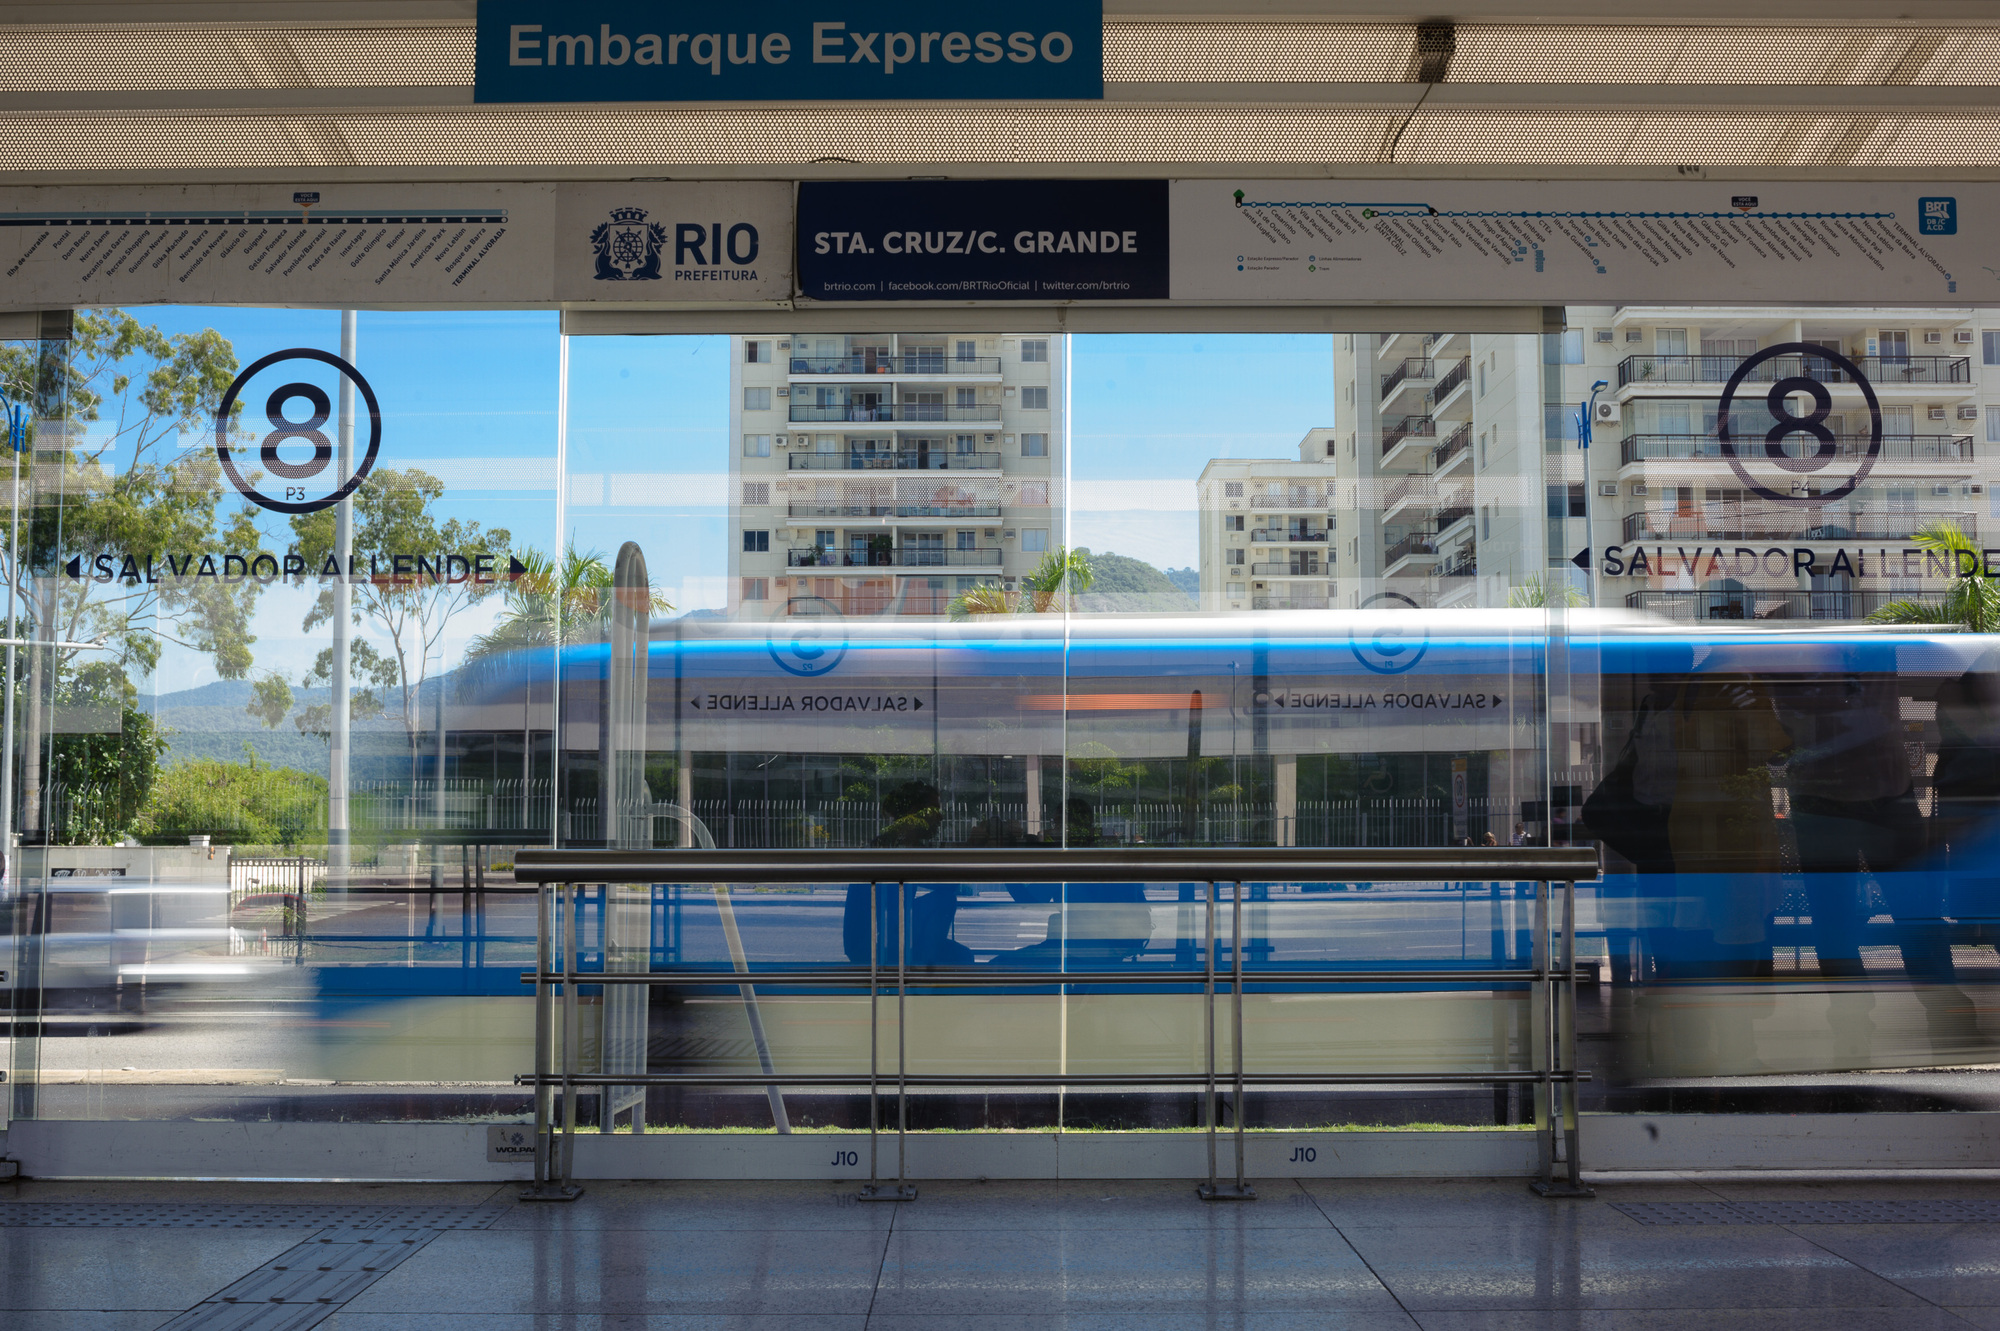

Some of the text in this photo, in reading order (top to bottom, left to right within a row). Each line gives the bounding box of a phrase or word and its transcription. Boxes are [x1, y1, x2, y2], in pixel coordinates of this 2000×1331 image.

[509, 21, 1073, 75] Embarque Expresso
[1271, 209, 1296, 234] Cesarinho
[1315, 209, 1342, 236] Cesarão III
[1331, 209, 1351, 230] Cesarão
[1345, 209, 1365, 230] Cesarão
[1926, 201, 1950, 212] BRT
[52, 230, 71, 249] Pontal
[386, 228, 406, 249] Riomar
[1242, 209, 1276, 244] Santa Eugênia
[1256, 209, 1291, 244] 31 de Outubro
[1285, 209, 1314, 238] Três Pontes
[1299, 209, 1333, 243] Vila Paciência
[1373, 223, 1407, 256] SANTA CRUZ
[1378, 219, 1405, 246] TERMINAL
[1391, 218, 1432, 258] General Olímpio
[1406, 218, 1443, 254] Gastão Rangel
[1421, 219, 1445, 243] Cajueiros
[1432, 218, 1462, 248] Curral Falso
[1450, 218, 1488, 257] Santa Veridiana
[1480, 218, 1513, 252] Pingo d'Água
[1494, 219, 1516, 242] Magarça
[1509, 219, 1533, 244] Mato Alto
[1523, 219, 1546, 243] Embrapa
[1568, 219, 1585, 237] Pontal
[1582, 219, 1611, 248] Dom Bosco
[1597, 219, 1627, 250] Notre Dame
[1641, 219, 1682, 260] Guiomar Novaes
[1656, 219, 1693, 256] Gilka Machado
[1672, 219, 1700, 248] Nova Barra
[1701, 219, 1729, 248] Gláucio Gil
[1714, 219, 1739, 244] Guignard
[1729, 220, 1767, 259] Gelson Fonseca
[1744, 220, 1786, 260] Salvador Allende
[1790, 220, 1815, 246] Interlagos
[1803, 220, 1840, 257] Golfe Olímpico
[1819, 220, 1839, 239] Riomar
[1848, 220, 1883, 255] Américas Park
[1862, 220, 1894, 252] Novo Leblon
[7, 231, 50, 277] Ilha de Guaratiba
[62, 230, 90, 261] Dom Bosco
[79, 230, 110, 263] Notre Dame
[82, 230, 130, 282] Recanto das Garças
[106, 230, 150, 276] Recreio Shopping
[128, 230, 169, 274] Guiomar Novaes
[152, 229, 189, 269] Gilka Machado
[179, 229, 209, 260] Nova Barra
[179, 229, 228, 283] Benvindo de Novaes
[220, 229, 248, 259] Gláucio Gil
[243, 228, 268, 254] Guignard
[249, 229, 287, 271] Gelson Fonseca
[265, 229, 307, 275] Salvador Allende
[283, 228, 327, 277] Pontões/Barrasul
[307, 229, 347, 271] Pedra de Itaúna
[340, 229, 367, 257] Interlagos
[350, 229, 387, 268] Golfe Olímpico
[375, 228, 426, 285] Santa Mônica Jardins
[410, 228, 447, 268] Américas Park
[434, 227, 466, 262] Novo Leblon
[445, 228, 486, 273] Bosque da Barra
[452, 227, 506, 287] TERMINAL ALVORADA
[675, 222, 759, 266] RIO
[814, 230, 1138, 255] STA. CRUZ/C. GRANDE
[1466, 219, 1511, 265] Vendas de Varanda
[1626, 219, 1669, 263] Recreio Shopping
[1760, 220, 1802, 262] Pontões/Barrasul
[1893, 222, 1947, 276] TERMINAL ALVORADA
[675, 270, 758, 281] PREFEITURA
[824, 280, 1130, 291] brtrio.com facebook.com/BRTRioOficial twitter.com/brtrio
[260, 382, 332, 480] 8
[1764, 376, 1836, 473] 8
[286, 487, 306, 501] P3
[1791, 480, 1811, 494] P4
[95, 554, 495, 584] SALVADOR ALLENDE
[1604, 545, 2000, 579] SALVADOR ALLENDE
[831, 1151, 858, 1166] J10
[1289, 1147, 1316, 1163] J10
